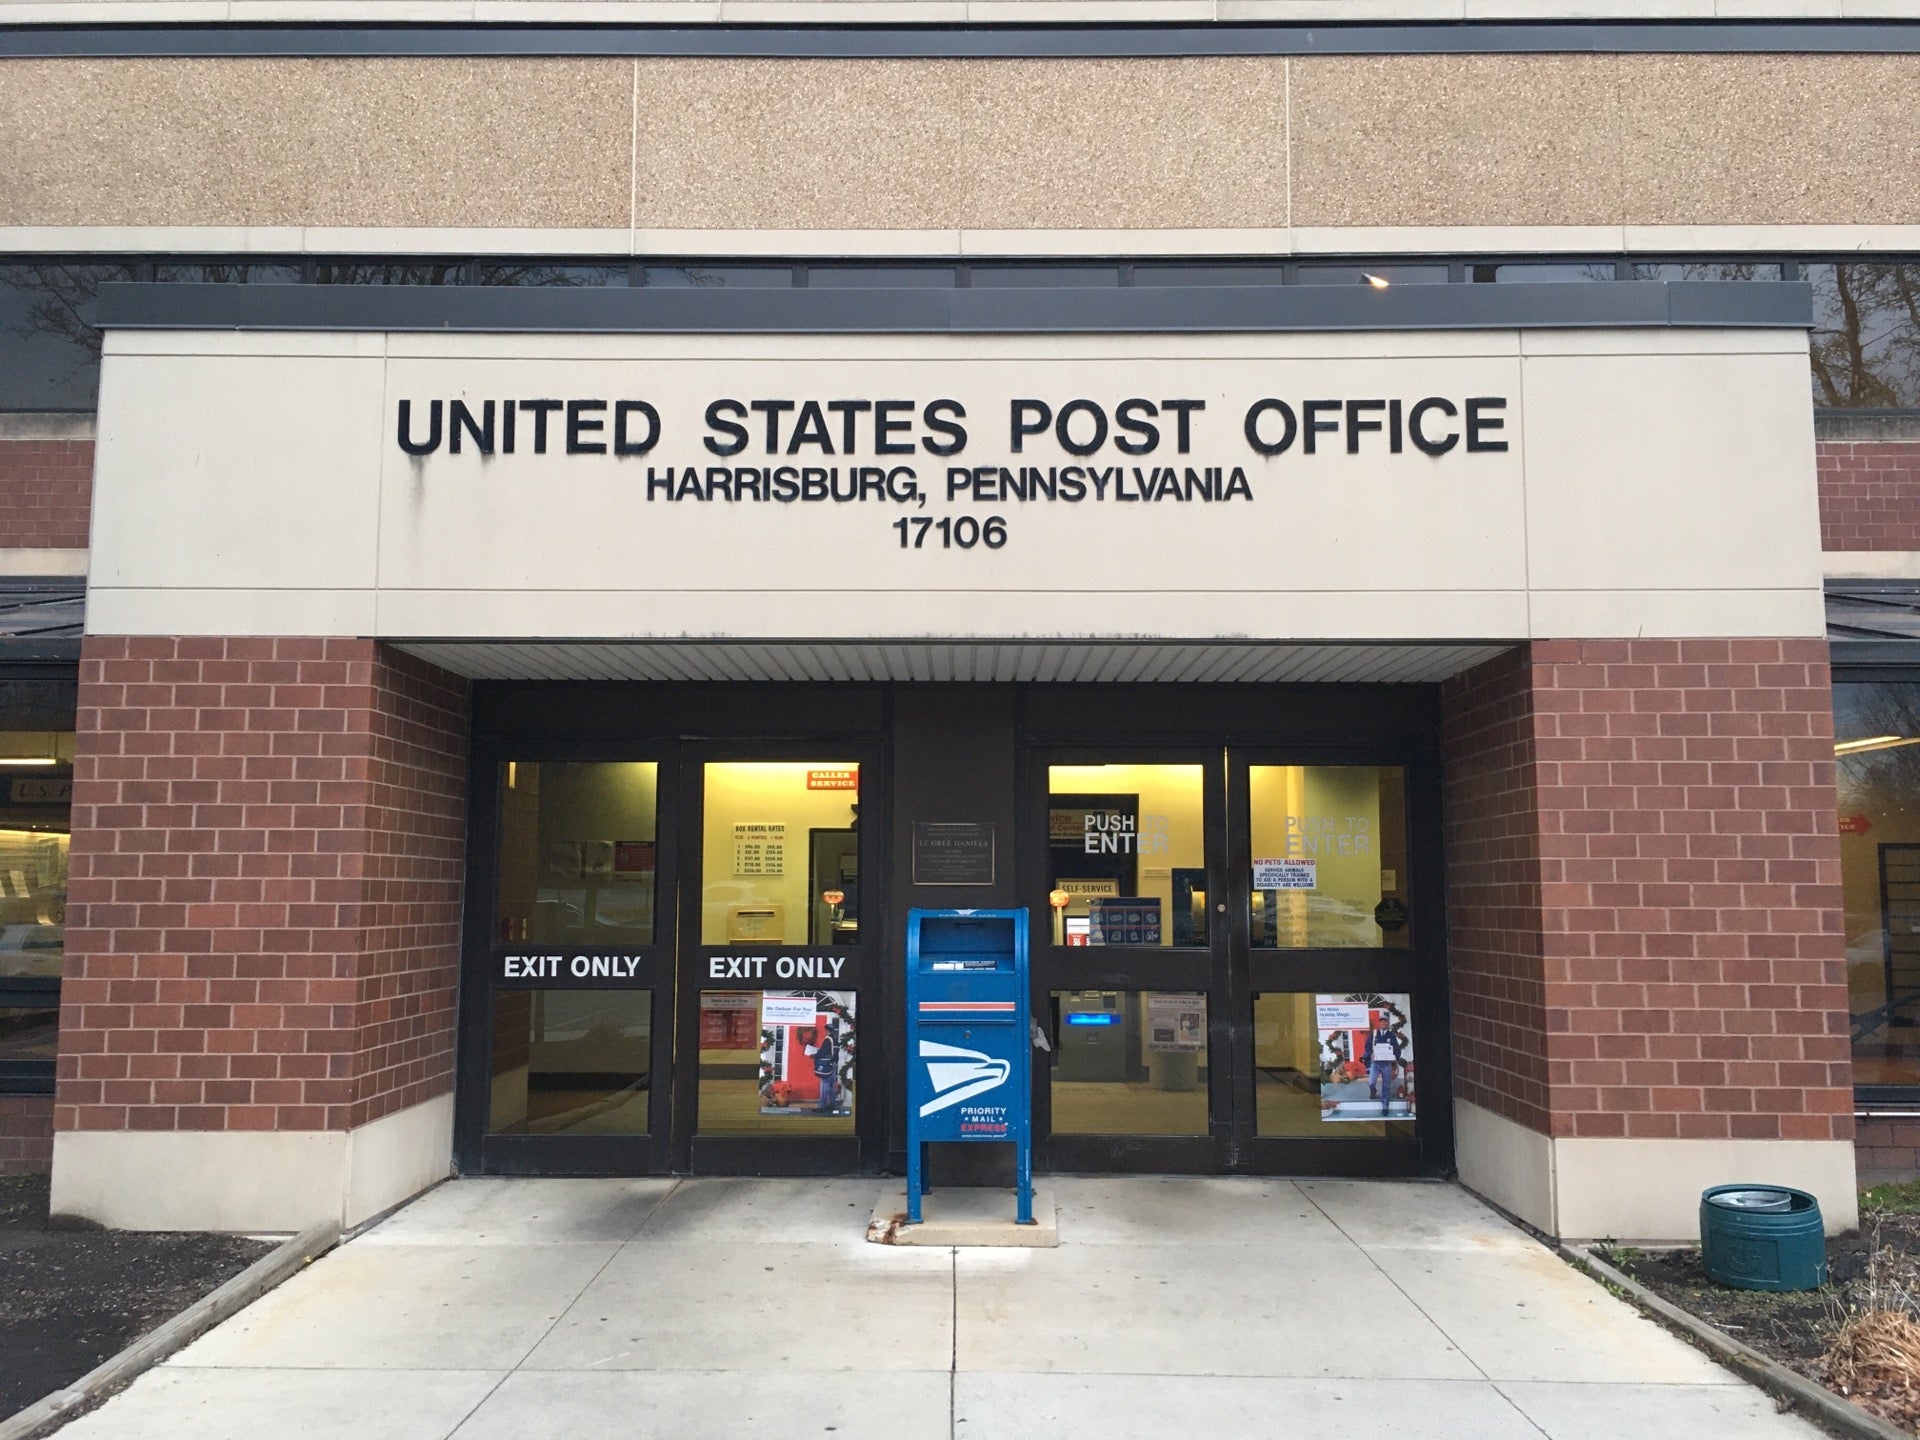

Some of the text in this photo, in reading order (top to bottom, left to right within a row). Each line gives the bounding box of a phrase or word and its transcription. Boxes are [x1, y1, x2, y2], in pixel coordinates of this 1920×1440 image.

[398, 397, 1508, 455] UNITED STATES POST OFFICE
[647, 467, 1253, 507] HARRISBURG, PENNSYLVANIA
[893, 516, 1007, 549] 17106
[1085, 815, 1168, 831] PUSH TO
[1285, 816, 1370, 832] PUSH TO
[1085, 832, 1168, 854] ENTER
[1286, 834, 1370, 855] ENTER
[1062, 885, 1112, 893] SELF-SERVICE
[504, 956, 641, 977] EXIT ONLY
[709, 957, 845, 978] EXIT ONLY
[961, 1123, 1006, 1132] EXPRESS
